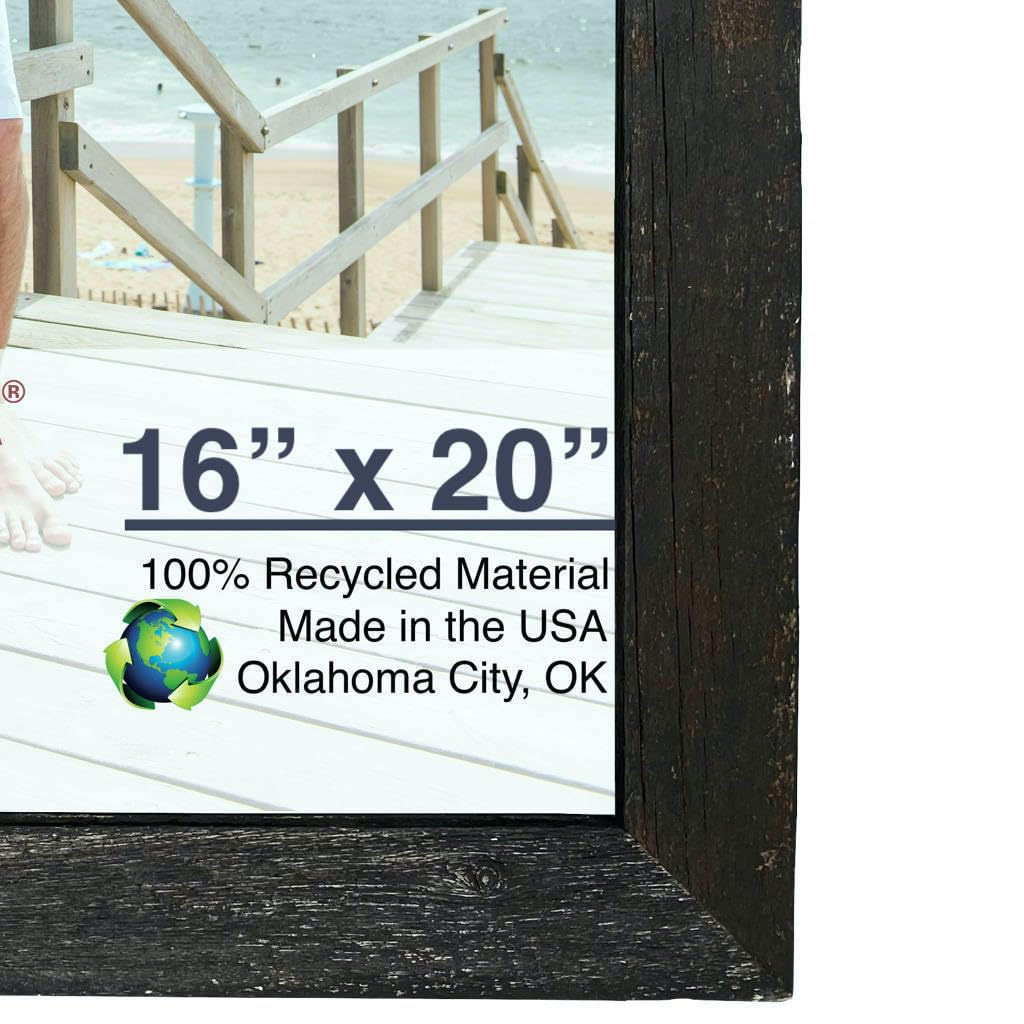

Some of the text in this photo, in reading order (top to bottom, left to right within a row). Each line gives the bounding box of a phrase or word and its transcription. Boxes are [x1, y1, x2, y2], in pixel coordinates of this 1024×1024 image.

[334, 448, 394, 511] x
[142, 557, 609, 599] 100% Recycled Material
[279, 609, 608, 643] Made in the USA
[237, 661, 608, 703] Oklahoma City, OK
